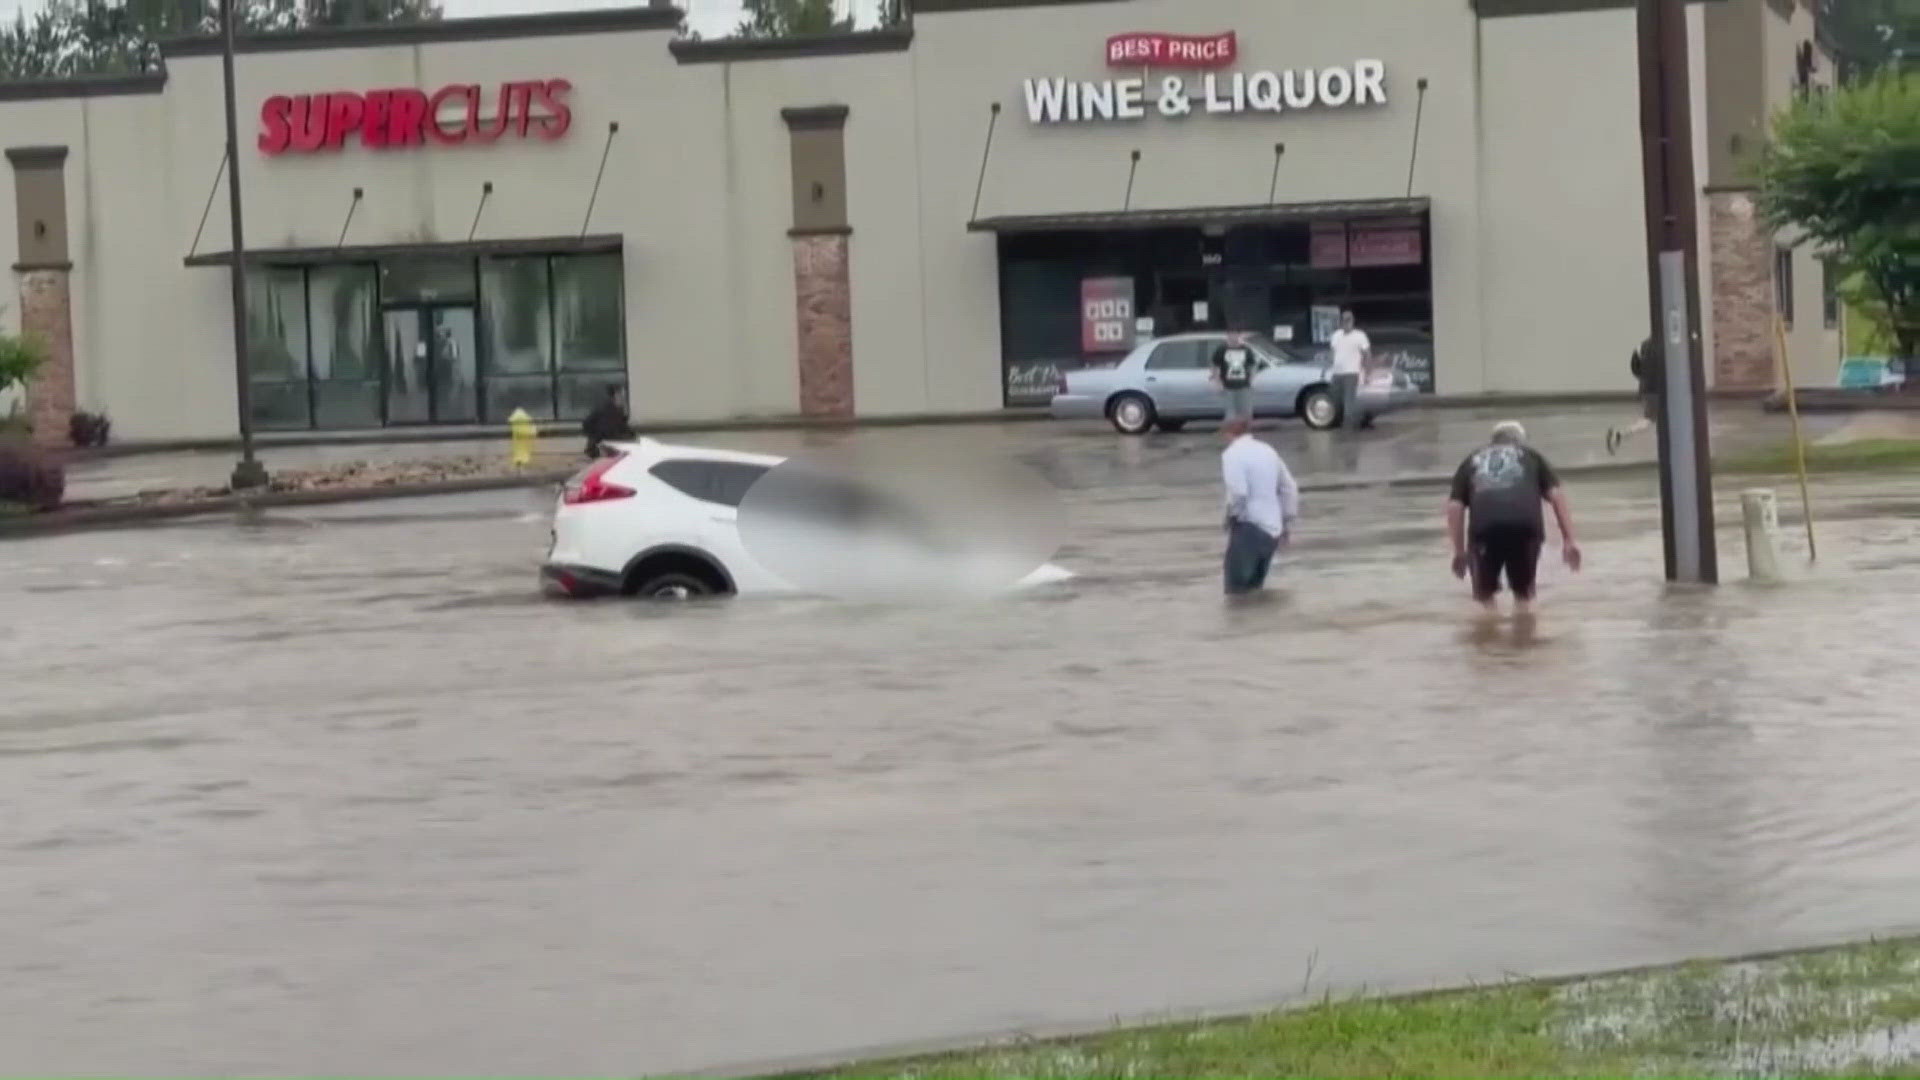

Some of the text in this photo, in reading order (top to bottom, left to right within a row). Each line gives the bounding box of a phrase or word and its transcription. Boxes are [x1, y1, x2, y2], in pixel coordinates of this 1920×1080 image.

[1110, 38, 1230, 60] BEST PRICE
[258, 78, 572, 157] SUPERCUTS
[1024, 58, 1387, 123] WINE & LIQUOR
